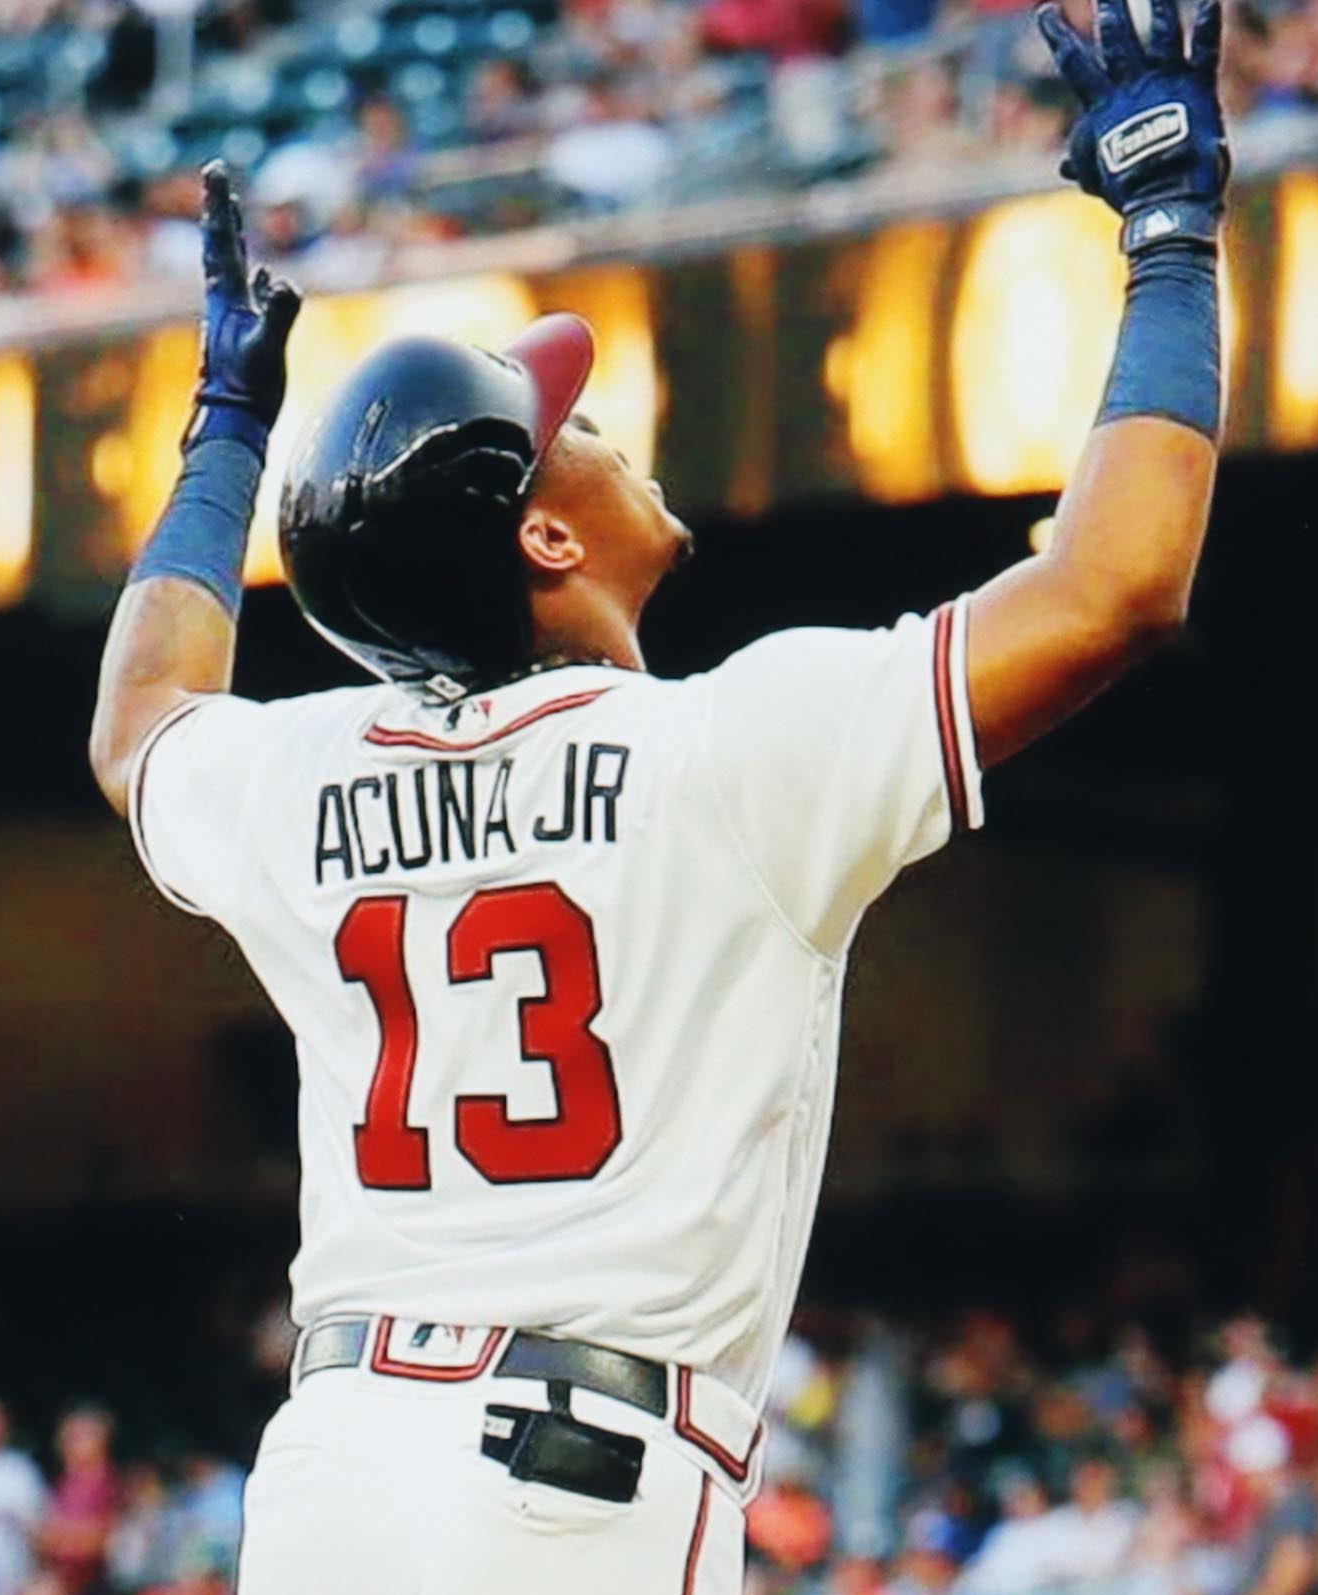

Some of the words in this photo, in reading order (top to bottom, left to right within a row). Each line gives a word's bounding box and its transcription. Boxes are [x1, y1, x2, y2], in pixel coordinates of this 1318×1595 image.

[315, 758, 517, 885] ACUNA
[534, 743, 630, 843] JR
[333, 880, 624, 1191] 13
